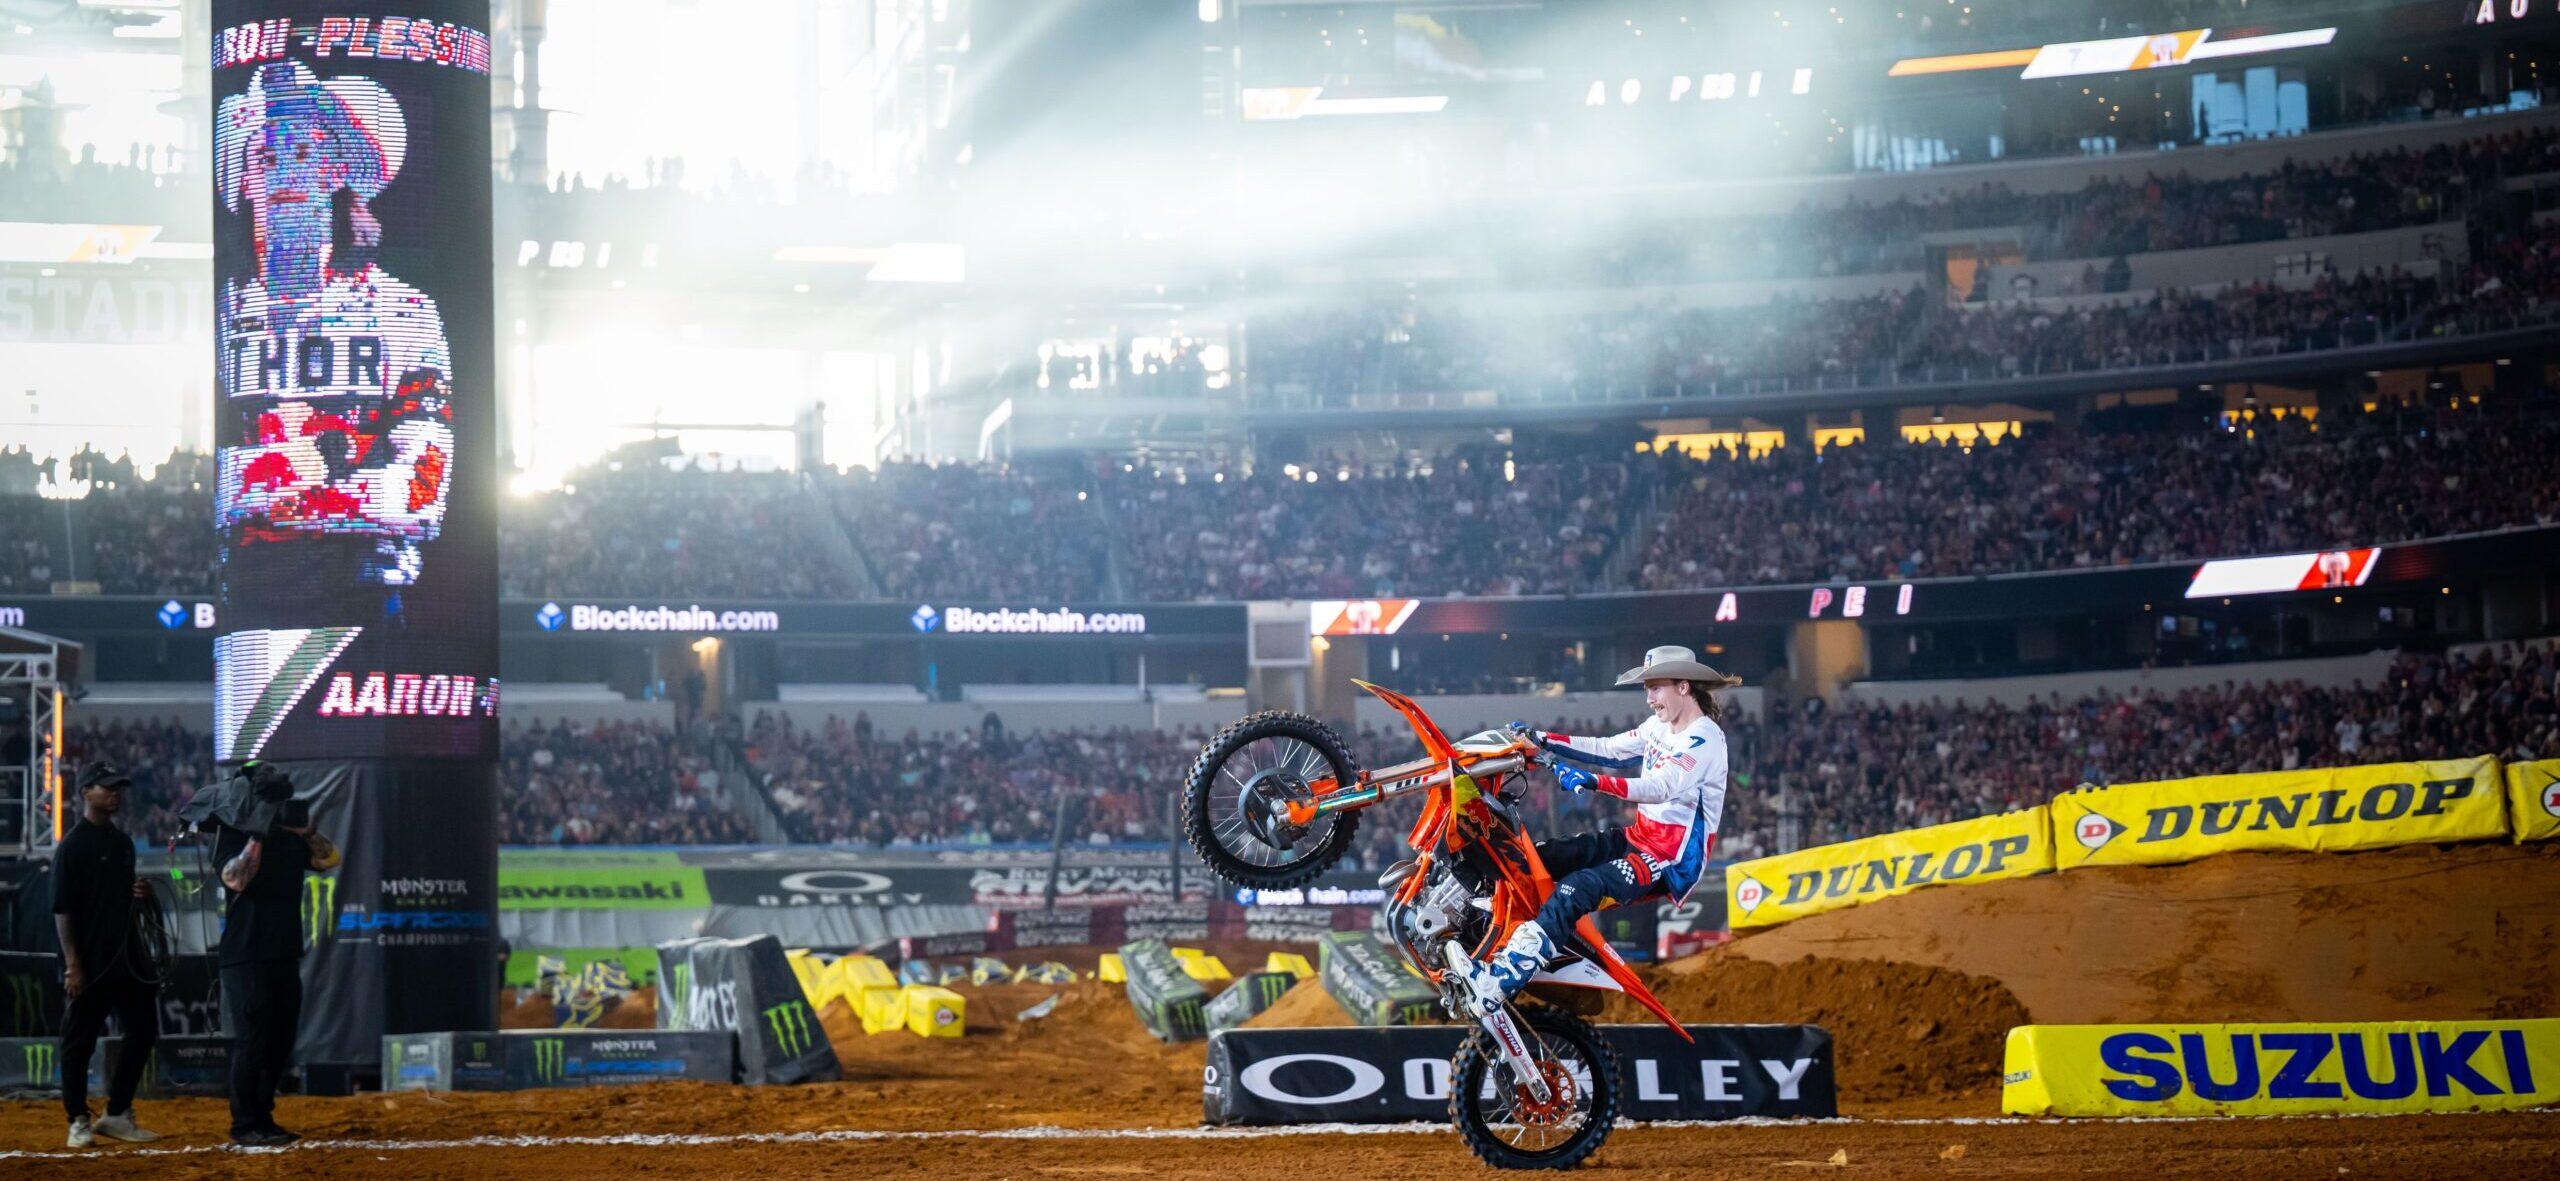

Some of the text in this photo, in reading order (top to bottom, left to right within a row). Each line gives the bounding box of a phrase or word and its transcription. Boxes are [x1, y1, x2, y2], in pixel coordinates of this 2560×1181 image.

[571, 604, 779, 631] Blockchain.com
[945, 606, 1146, 633] Blockchain.com
[2137, 777, 2475, 844] DUNLOP
[1779, 834, 2030, 906] DUNLOP
[380, 877, 468, 895] MONSTER
[2003, 1069, 2032, 1085] SUZUKI
[2100, 1029, 2536, 1102] SUZUKI
